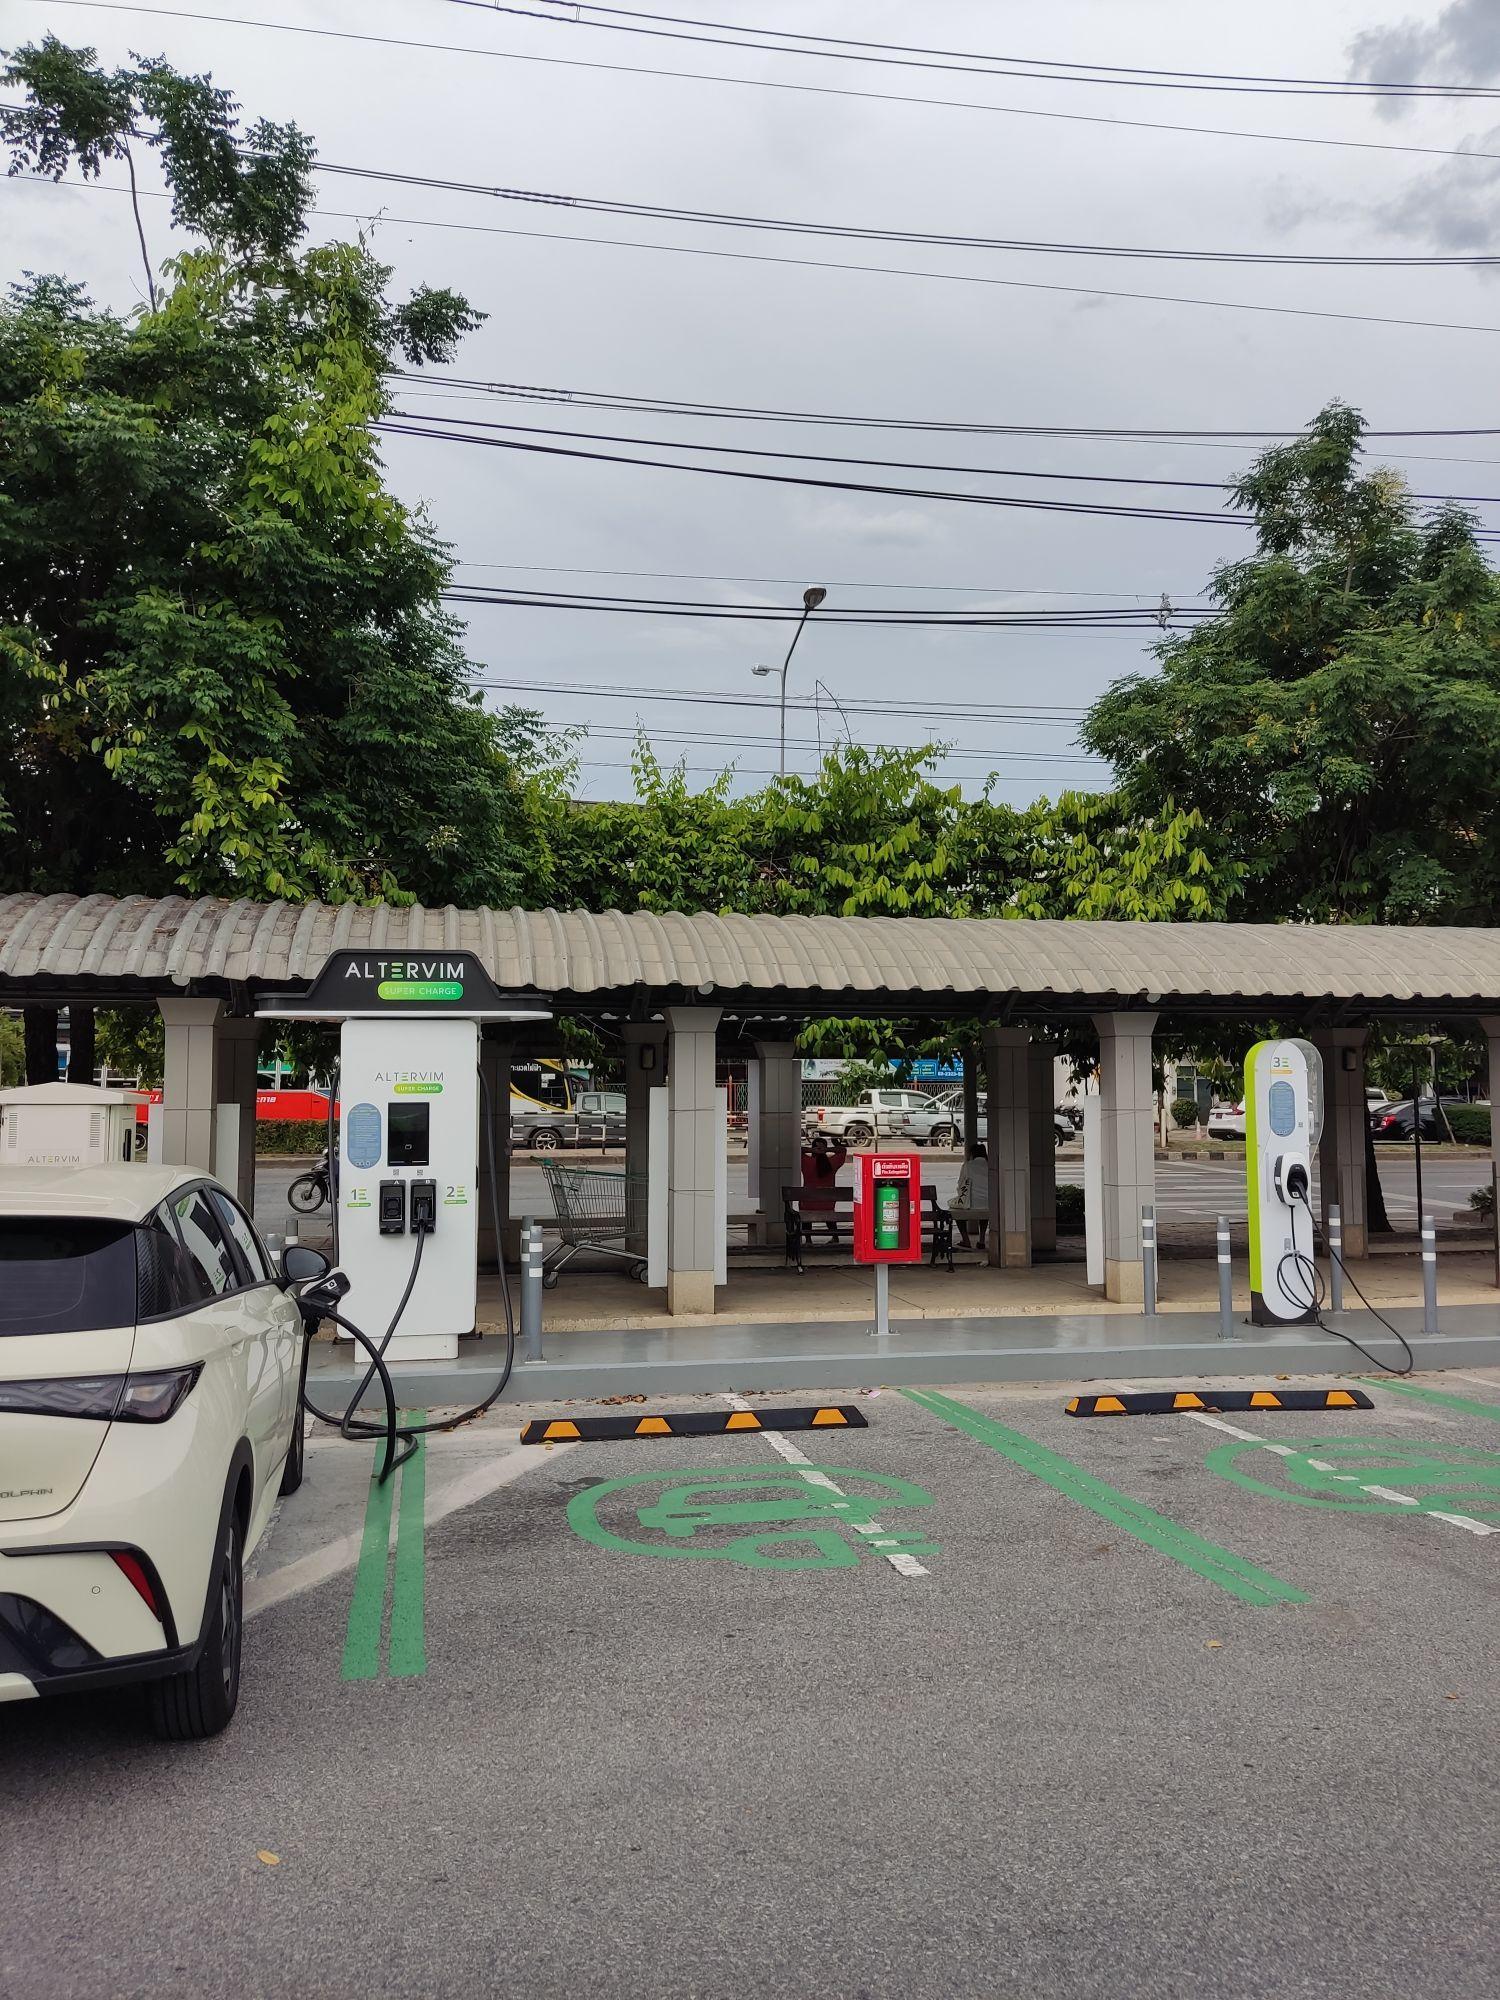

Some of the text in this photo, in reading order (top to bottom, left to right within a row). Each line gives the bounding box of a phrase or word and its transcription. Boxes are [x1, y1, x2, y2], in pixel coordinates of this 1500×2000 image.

[344, 961, 464, 979] ALTERVIM
[384, 987, 457, 995] SUPER CHARGE
[374, 1071, 444, 1082] ALTERVIM
[27, 1155, 80, 1164] ALTERVIM
[0, 1488, 53, 1499] OLPHIN
